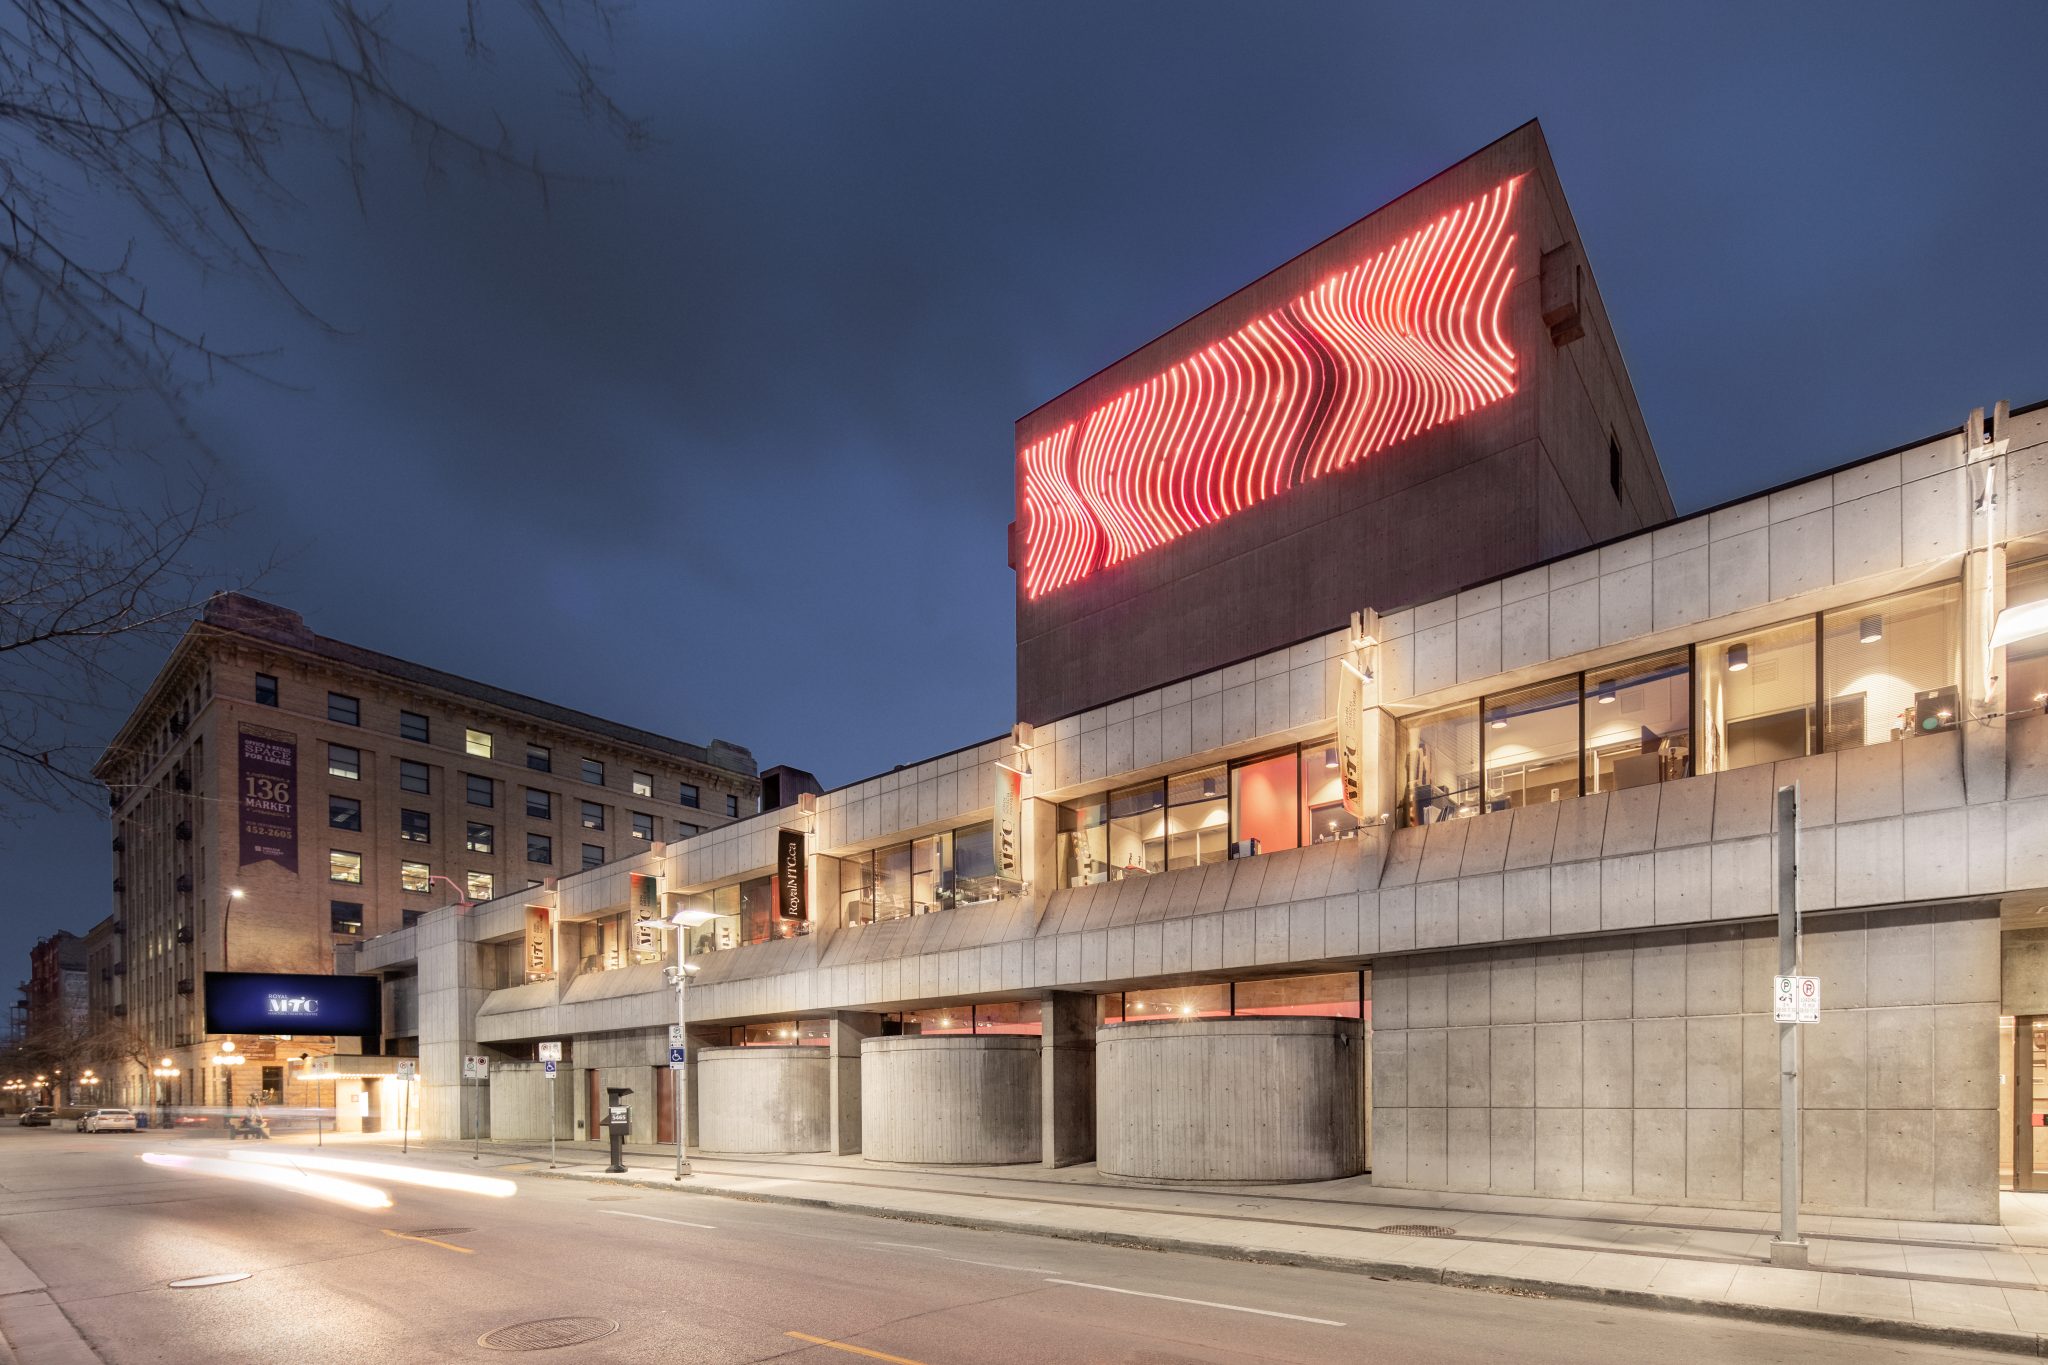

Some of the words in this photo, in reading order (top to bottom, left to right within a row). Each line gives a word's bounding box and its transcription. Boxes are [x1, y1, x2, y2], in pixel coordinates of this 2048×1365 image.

[244, 744, 292, 760] SPACE
[245, 752, 263, 761] FOR
[264, 756, 291, 766] LEASE
[246, 777, 290, 803] 136
[246, 798, 292, 813] MARKET
[246, 825, 292, 840] 452-2605
[787, 842, 800, 915] RoyalMTC.ca
[268, 996, 319, 1013] MTC
